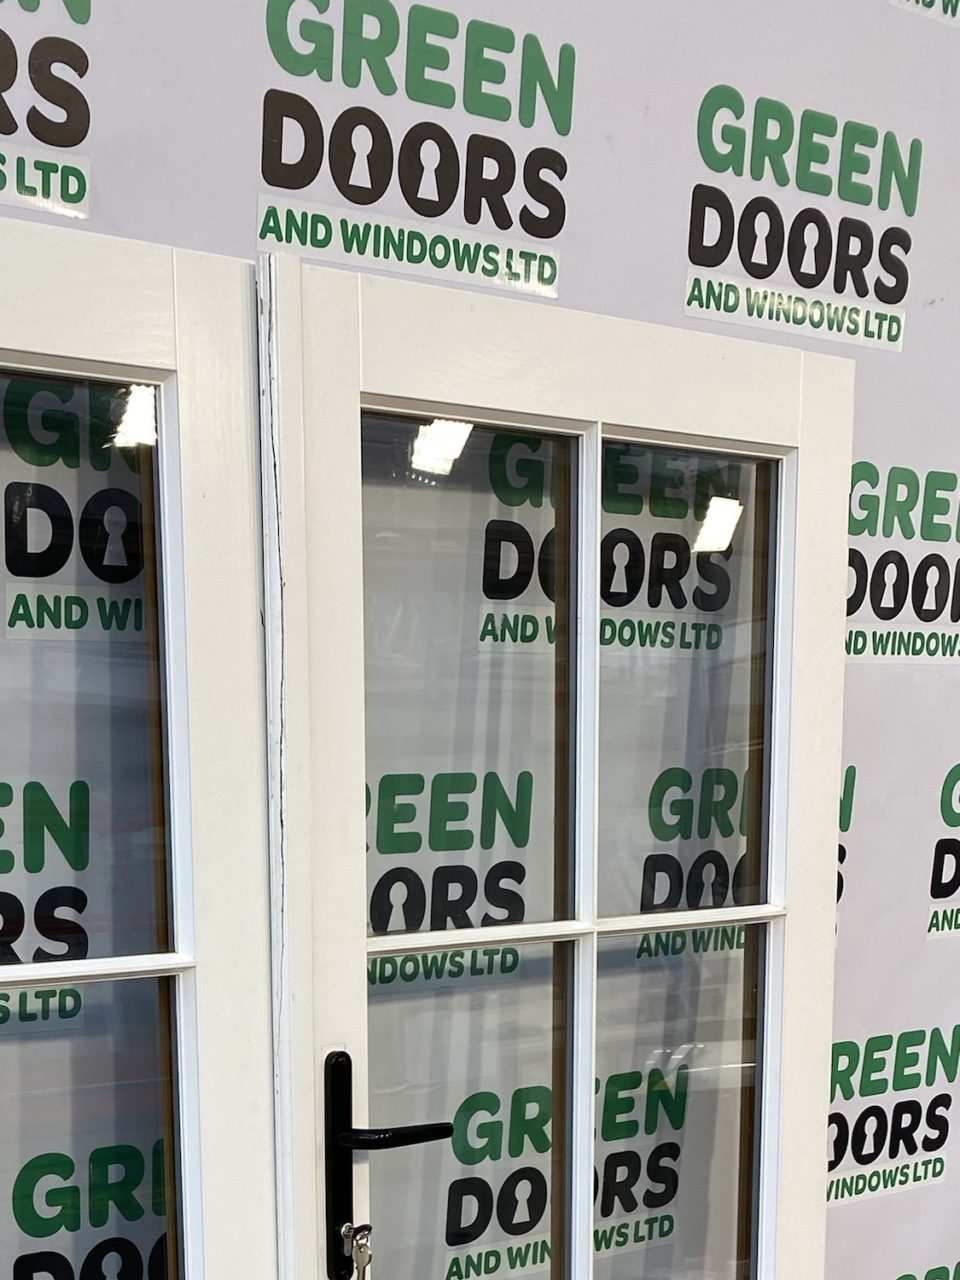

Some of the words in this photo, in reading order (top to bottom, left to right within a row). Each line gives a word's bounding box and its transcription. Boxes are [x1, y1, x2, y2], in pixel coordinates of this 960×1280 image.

[266, 0, 576, 136] GREEN
[16, 156, 87, 204] LTD
[261, 88, 568, 239] DOORS
[697, 84, 923, 217] GREEN
[259, 205, 333, 250] AND
[340, 218, 500, 277] WINDOWS
[505, 248, 557, 286] LTD
[688, 183, 912, 305] DOORS
[686, 277, 740, 313] AND
[745, 287, 860, 335] WINDOWS
[863, 310, 902, 342] LTD
[848, 461, 960, 543] GRE
[7, 593, 90, 631] AND
[479, 613, 539, 644] AND
[679, 622, 723, 650] LTD
[872, 630, 960, 657] WINDOW
[366, 770, 533, 855] EEN
[470, 947, 519, 977] LTD
[636, 930, 687, 959] AND
[18, 988, 82, 1023] LTD
[451, 1063, 689, 1166] GREN
[445, 1141, 681, 1247] DORS
[913, 1156, 945, 1183] LTD
[633, 1214, 675, 1244] LTD
